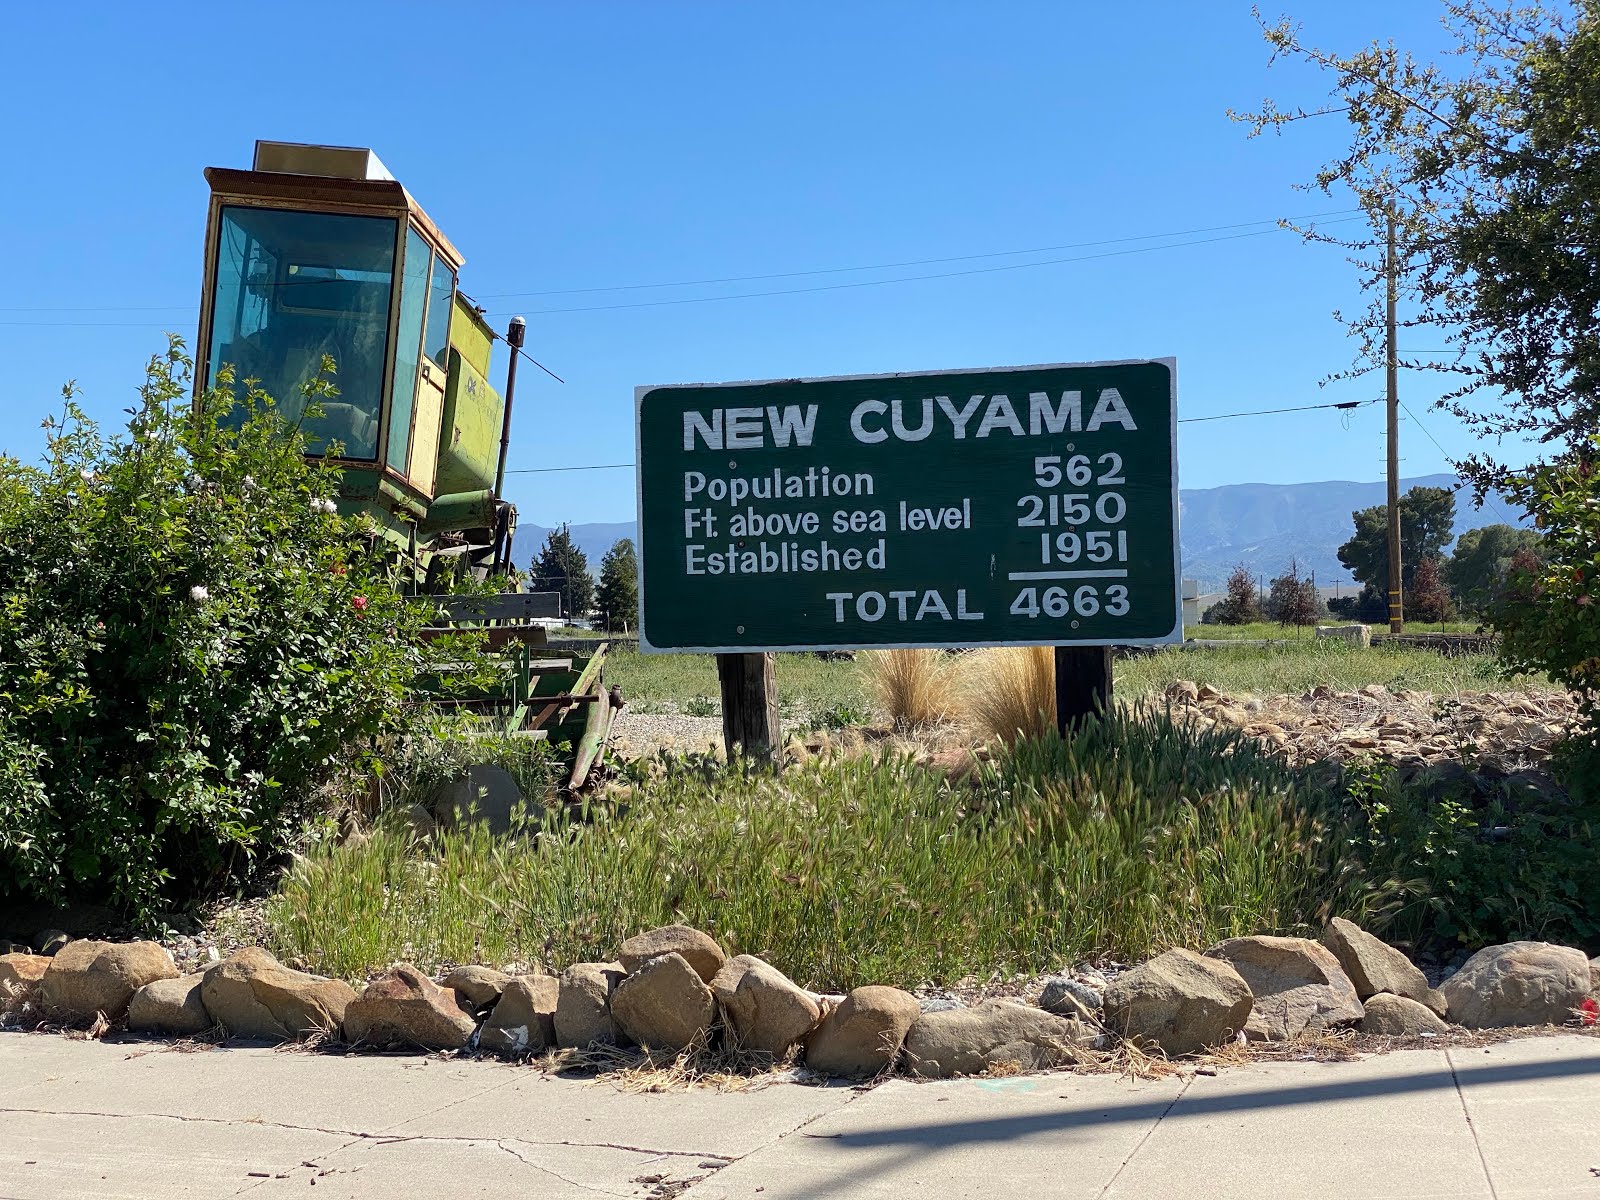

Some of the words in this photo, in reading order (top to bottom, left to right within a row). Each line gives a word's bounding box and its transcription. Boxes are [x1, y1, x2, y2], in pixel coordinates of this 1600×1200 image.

[684, 405, 818, 450] NEW
[851, 388, 1137, 443] CUYAMA
[685, 467, 873, 506] Population
[1035, 453, 1125, 487] 562
[685, 508, 718, 537] Ft.
[730, 507, 819, 536] above
[833, 510, 886, 532] sea
[900, 499, 970, 530] level
[1018, 492, 1126, 526] 2150
[687, 539, 885, 574] Established
[1042, 531, 1127, 563] 1951
[826, 590, 983, 622] TOTAL
[1010, 585, 1129, 617] 4663
